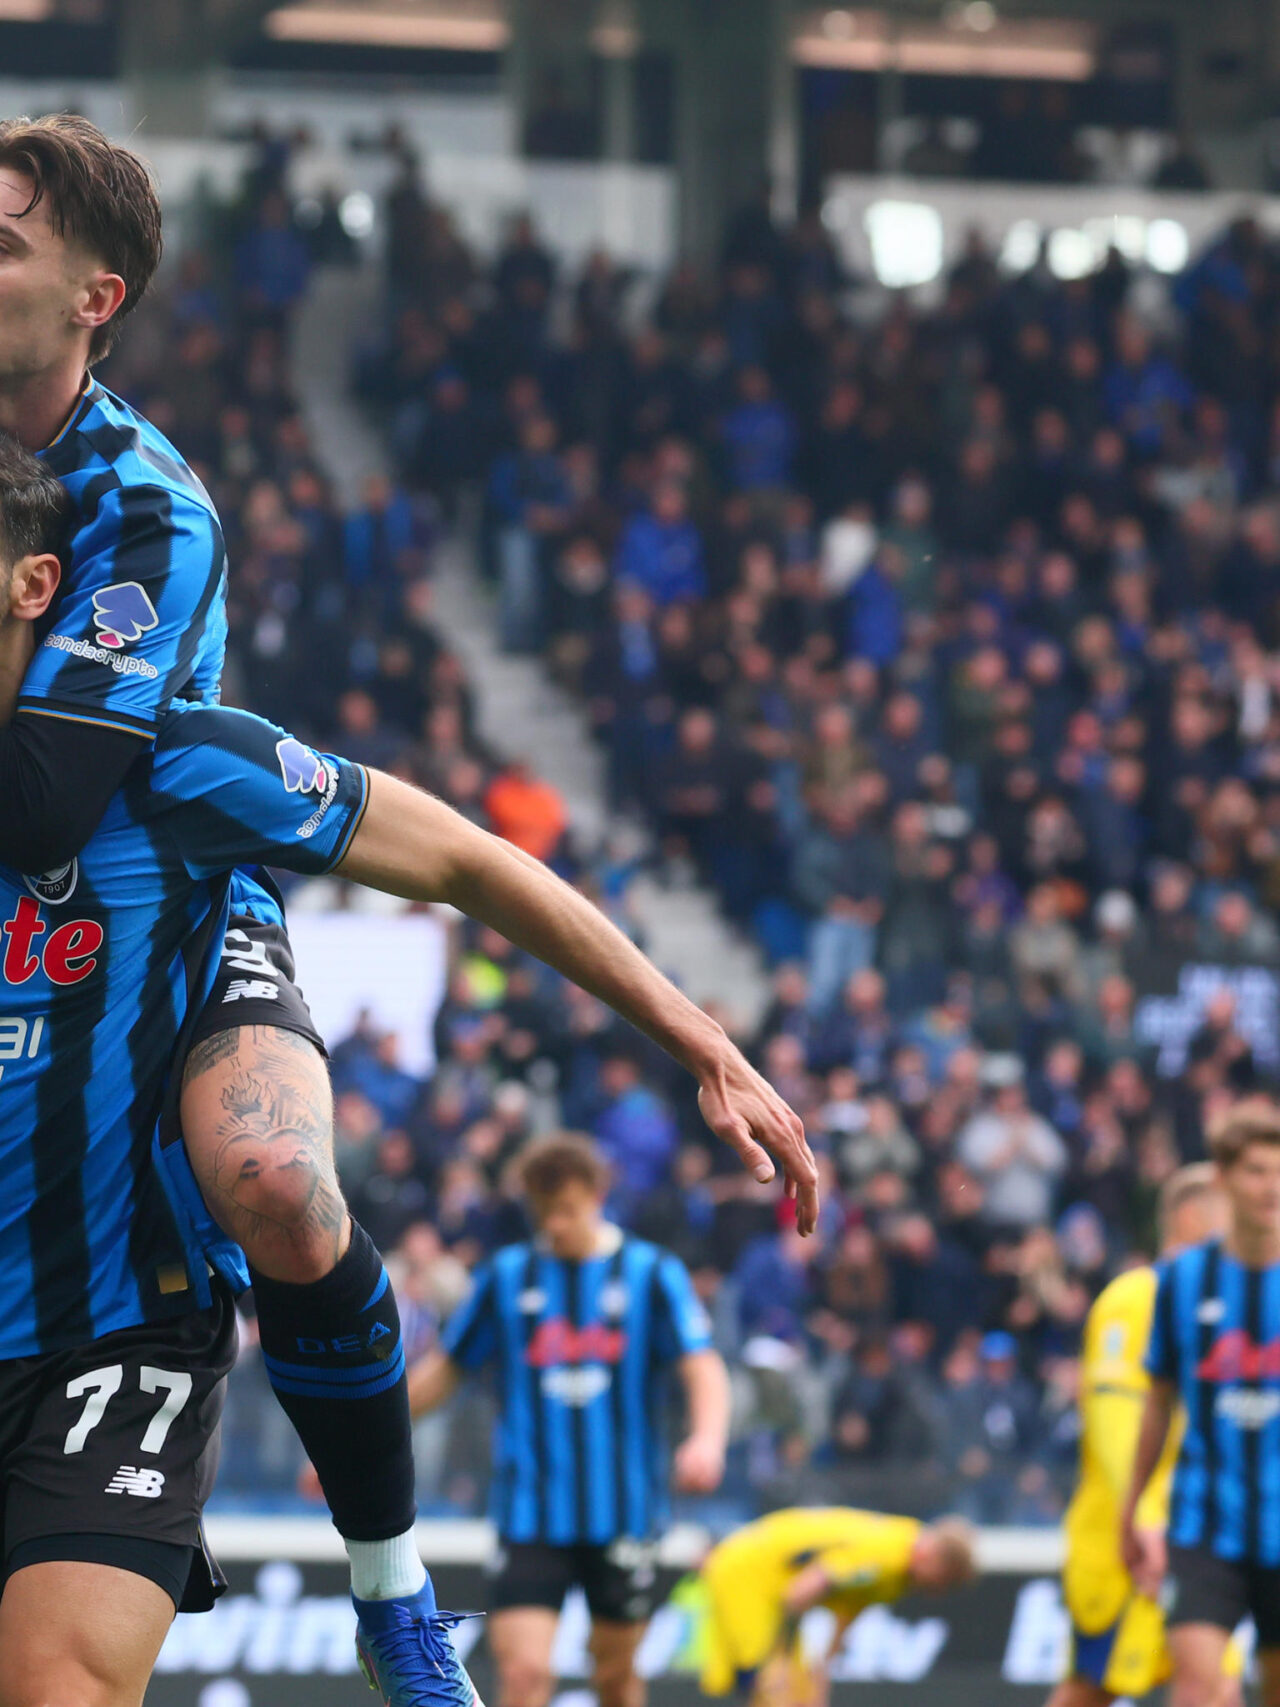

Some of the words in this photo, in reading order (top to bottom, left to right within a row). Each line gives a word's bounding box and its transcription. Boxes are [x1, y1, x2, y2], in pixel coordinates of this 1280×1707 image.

[43, 880, 66, 894] 1907
[296, 1321, 391, 1353] DEA
[63, 1364, 193, 1455] 77
